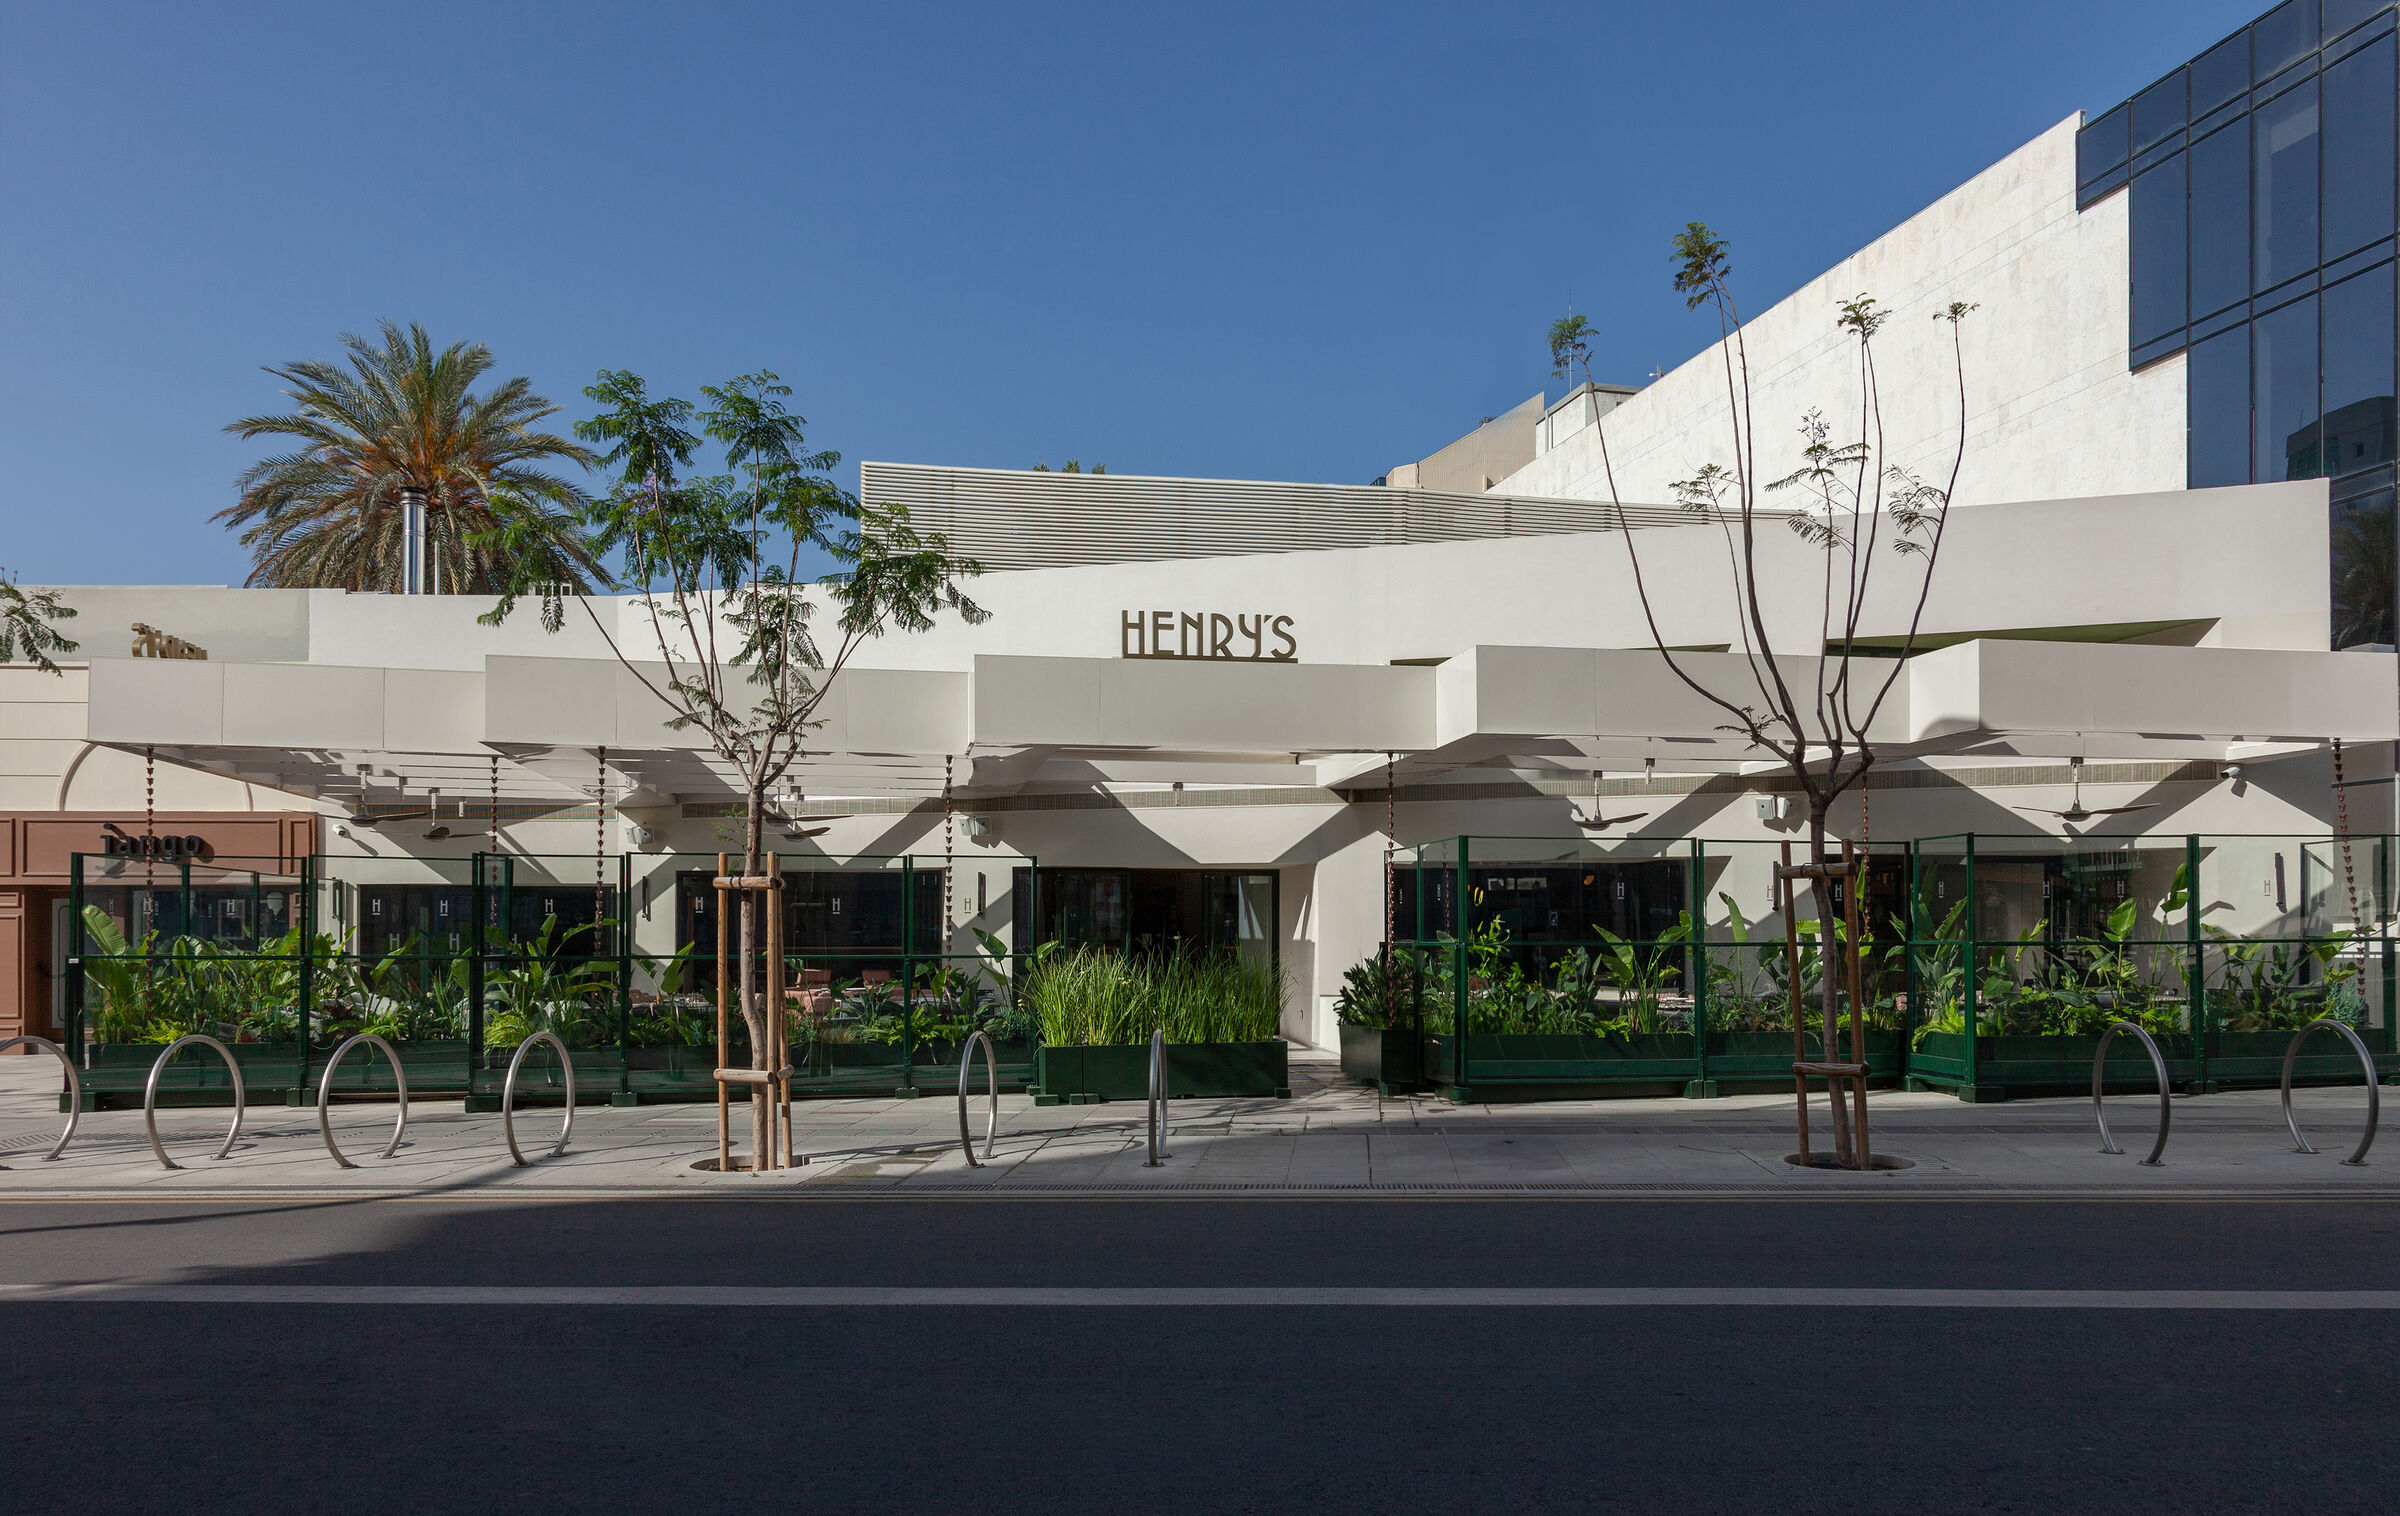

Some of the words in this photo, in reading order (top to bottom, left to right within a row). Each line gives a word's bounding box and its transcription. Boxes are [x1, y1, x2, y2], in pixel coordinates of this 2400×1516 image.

[1122, 609, 1297, 660] HENRY'S
[1617, 882, 1625, 896] H
[1835, 884, 1843, 898] H
[1938, 881, 1944, 895] H
[2043, 881, 2050, 895] H
[2117, 880, 2124, 895] H
[2264, 880, 2271, 893] H
[143, 897, 152, 912] H
[226, 898, 234, 912] H
[372, 898, 381, 912] H
[440, 899, 448, 913] H
[544, 898, 554, 912] H
[695, 896, 704, 910] H
[832, 897, 840, 911] H
[964, 898, 971, 911] H
[449, 932, 459, 951] H
